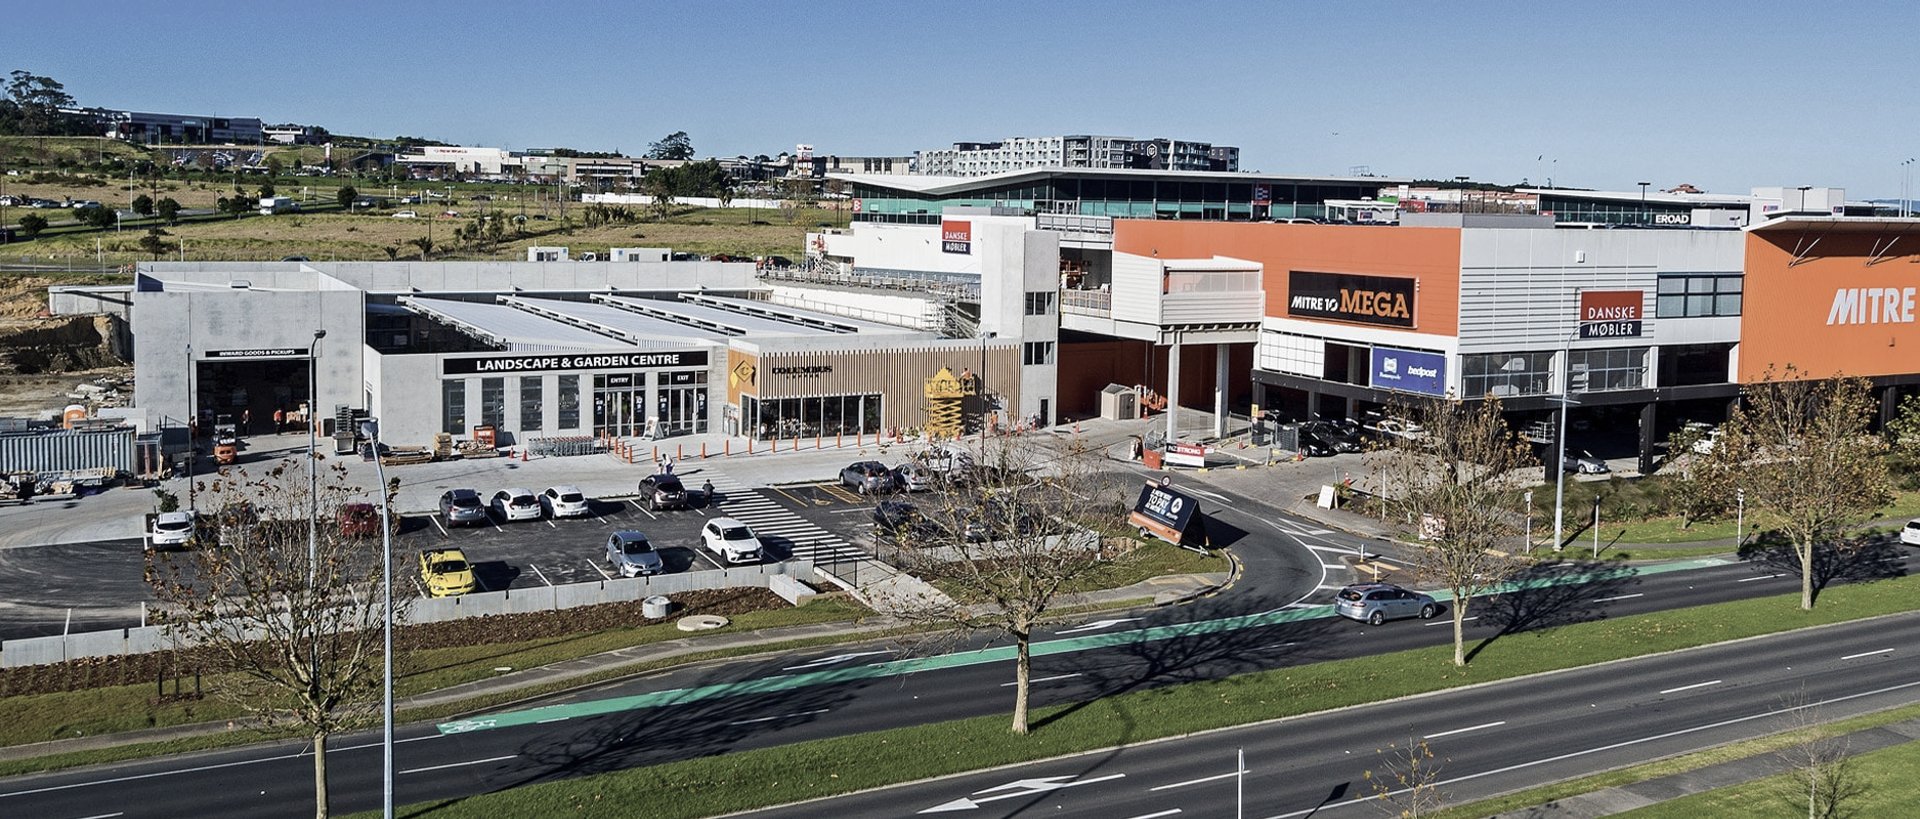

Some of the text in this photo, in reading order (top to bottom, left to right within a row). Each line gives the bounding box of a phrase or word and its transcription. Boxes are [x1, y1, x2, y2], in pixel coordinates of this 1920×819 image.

[1655, 214, 1689, 224] EROAD
[944, 231, 967, 240] DANSKE
[1291, 288, 1410, 319] MITRE 10 MEGA
[1826, 287, 1916, 325] MITRE
[1588, 306, 1635, 319] DANSKE
[1588, 323, 1633, 336] MØBLER
[476, 354, 680, 371] LANDSCAPE & GARDEN CENTRE
[772, 365, 832, 374] COLUMBUS
[1408, 365, 1437, 378] bedpost
[1149, 494, 1170, 509] TO PAY
